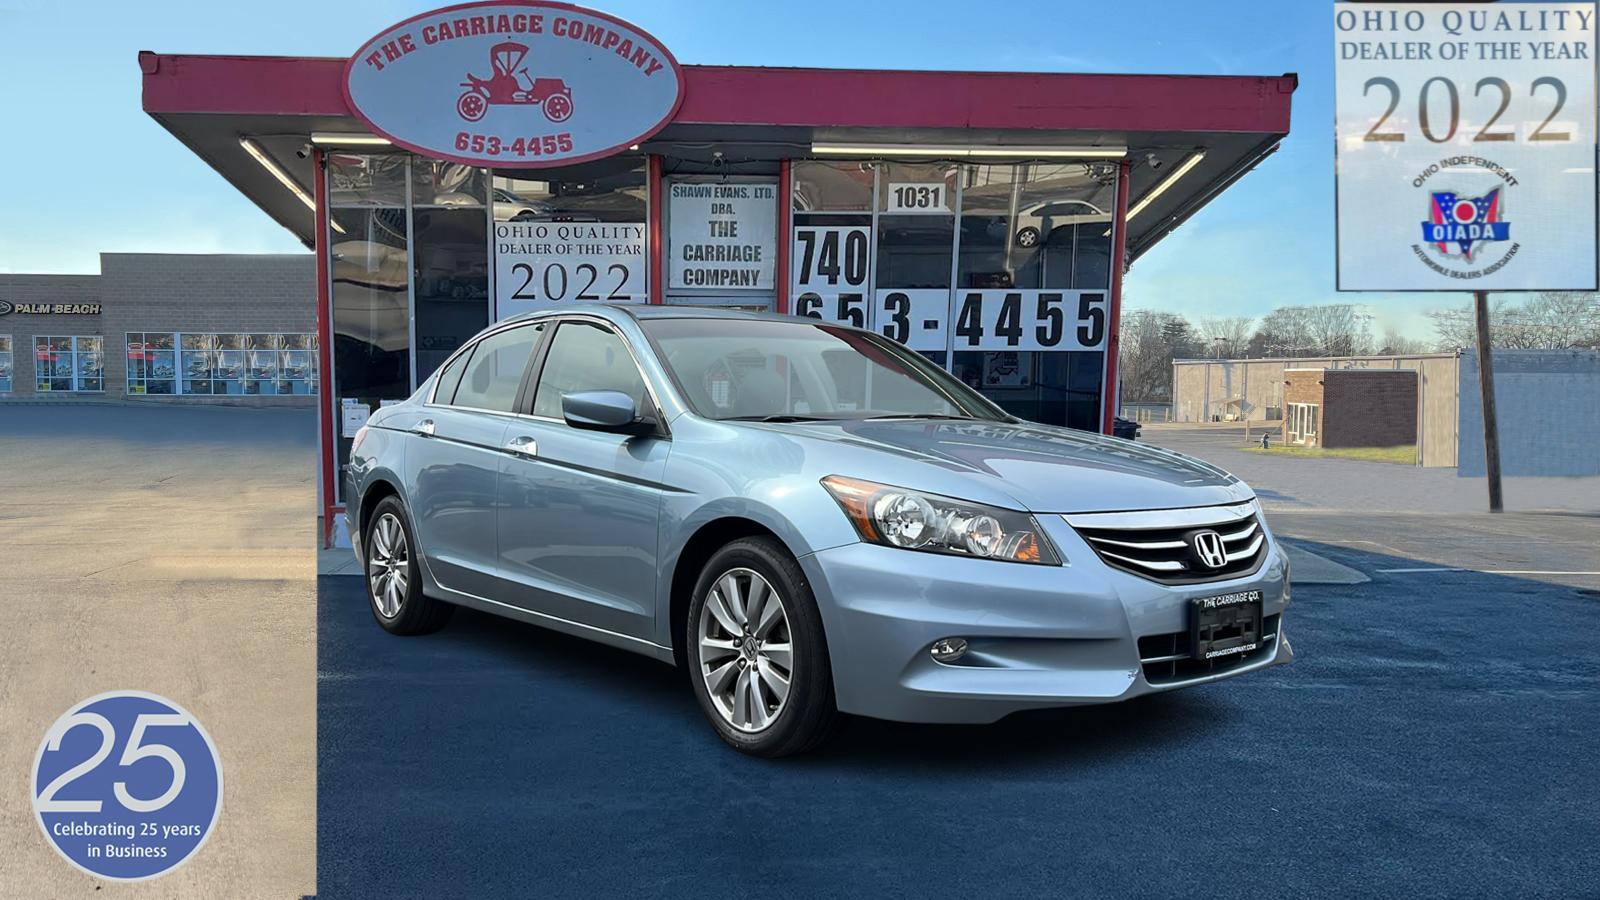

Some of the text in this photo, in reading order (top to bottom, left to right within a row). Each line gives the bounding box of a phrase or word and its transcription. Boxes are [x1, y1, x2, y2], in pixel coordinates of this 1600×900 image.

[1336, 10, 1593, 36] OHIO QUALITY
[366, 14, 664, 77] THE CARRIAGE COMPANY
[1340, 42, 1589, 60] DEALER OF THE YEAR
[1363, 76, 1571, 143] 2022
[455, 132, 573, 157] 653-4455
[1413, 156, 1519, 187] OHIO INDEPENDENT
[672, 186, 713, 199] SHAWN
[754, 187, 775, 200] LTD.
[894, 186, 940, 209] 1031
[711, 203, 736, 216] DBA.
[497, 226, 643, 241] OHIO QUALITY
[708, 220, 738, 237] THE
[1433, 224, 1494, 240] OIADA
[499, 243, 641, 256] DEALER OF THE YEAR
[683, 244, 762, 263] CARRIAGE
[797, 230, 867, 286] 740
[511, 263, 631, 301] 2022
[683, 268, 760, 286] COMPANY
[15, 304, 51, 314] PALM
[1216, 593, 1248, 606] CARRIAGE
